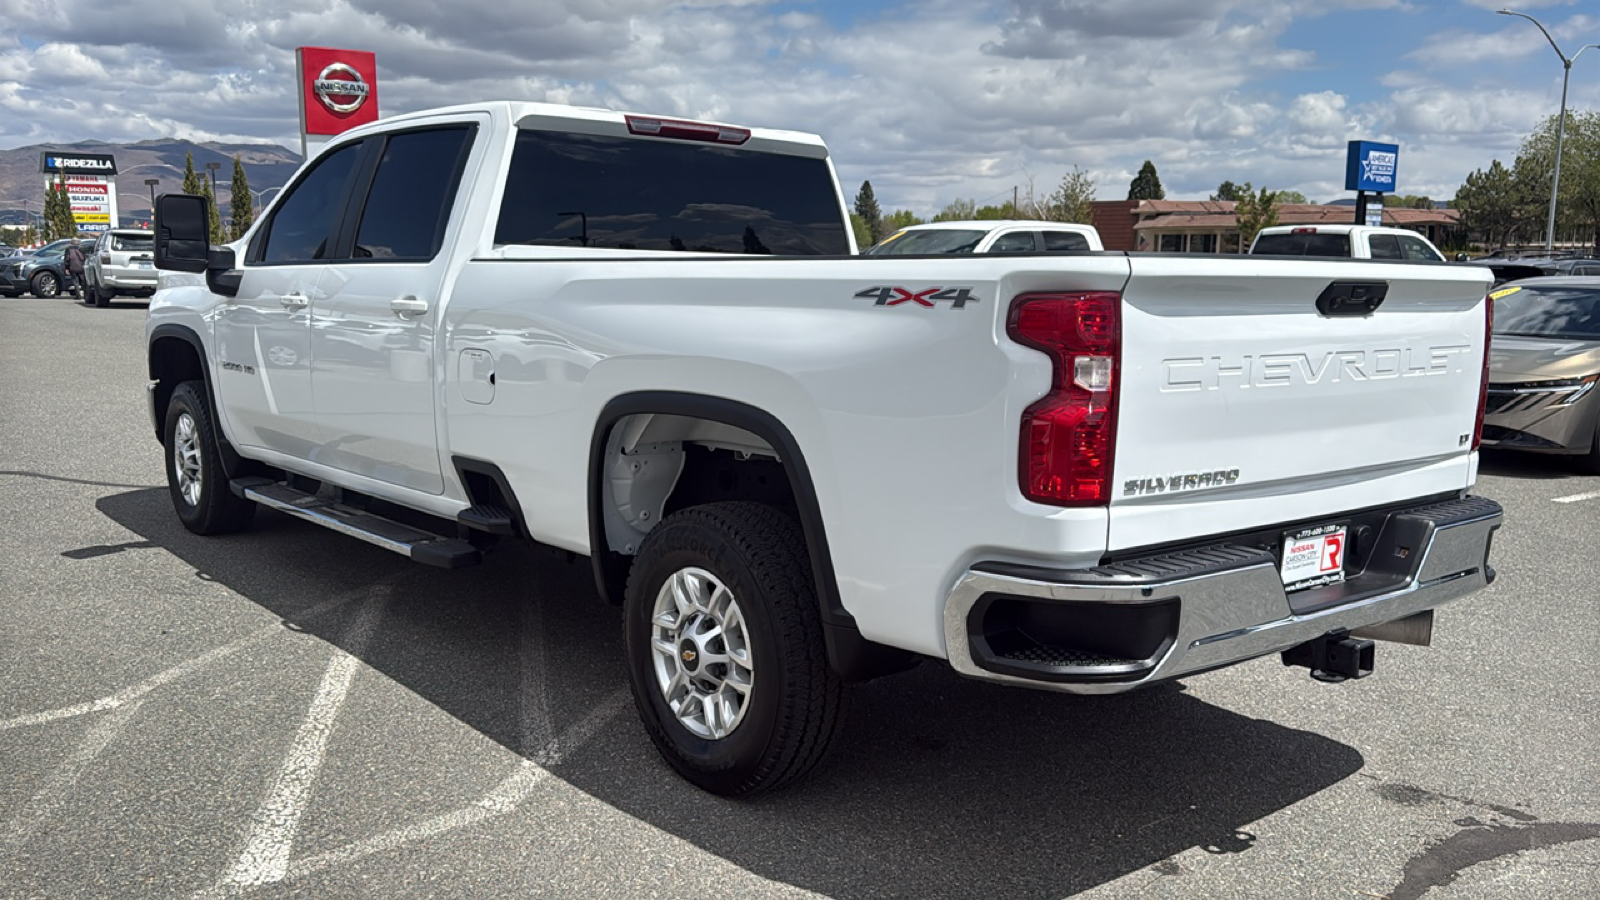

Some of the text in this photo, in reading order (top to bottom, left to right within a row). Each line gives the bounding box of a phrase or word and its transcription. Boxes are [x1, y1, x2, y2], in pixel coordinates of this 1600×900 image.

[320, 82, 365, 92] NISSAN
[63, 158, 113, 169] RIDEZILLA
[1159, 345, 1471, 394] CHEVROLET
[1123, 467, 1240, 496] SILVERADO
[1290, 544, 1315, 554] NISSAN
